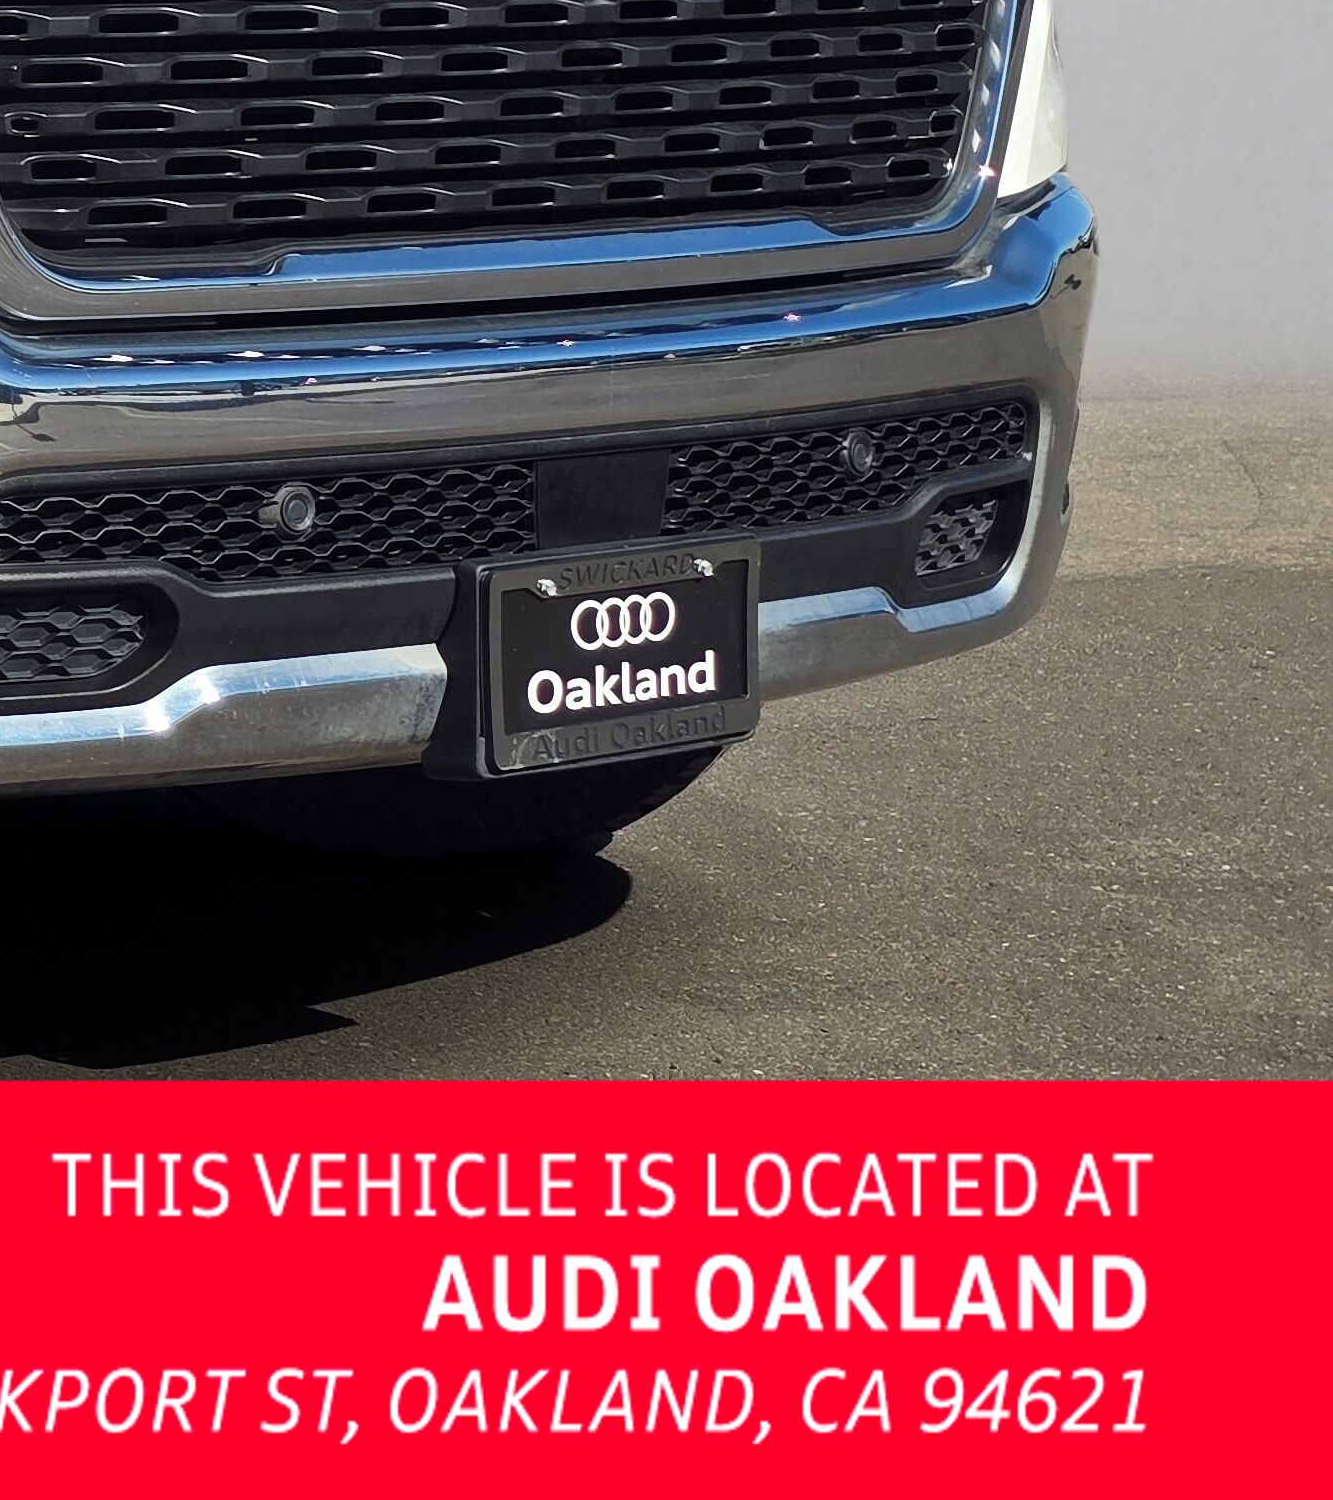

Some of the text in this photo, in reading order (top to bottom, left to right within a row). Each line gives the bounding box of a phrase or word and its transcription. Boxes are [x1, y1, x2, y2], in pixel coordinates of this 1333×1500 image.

[557, 552, 696, 592] SWICKARD
[527, 649, 717, 714] Oakland
[532, 704, 727, 761] Audi Oakland
